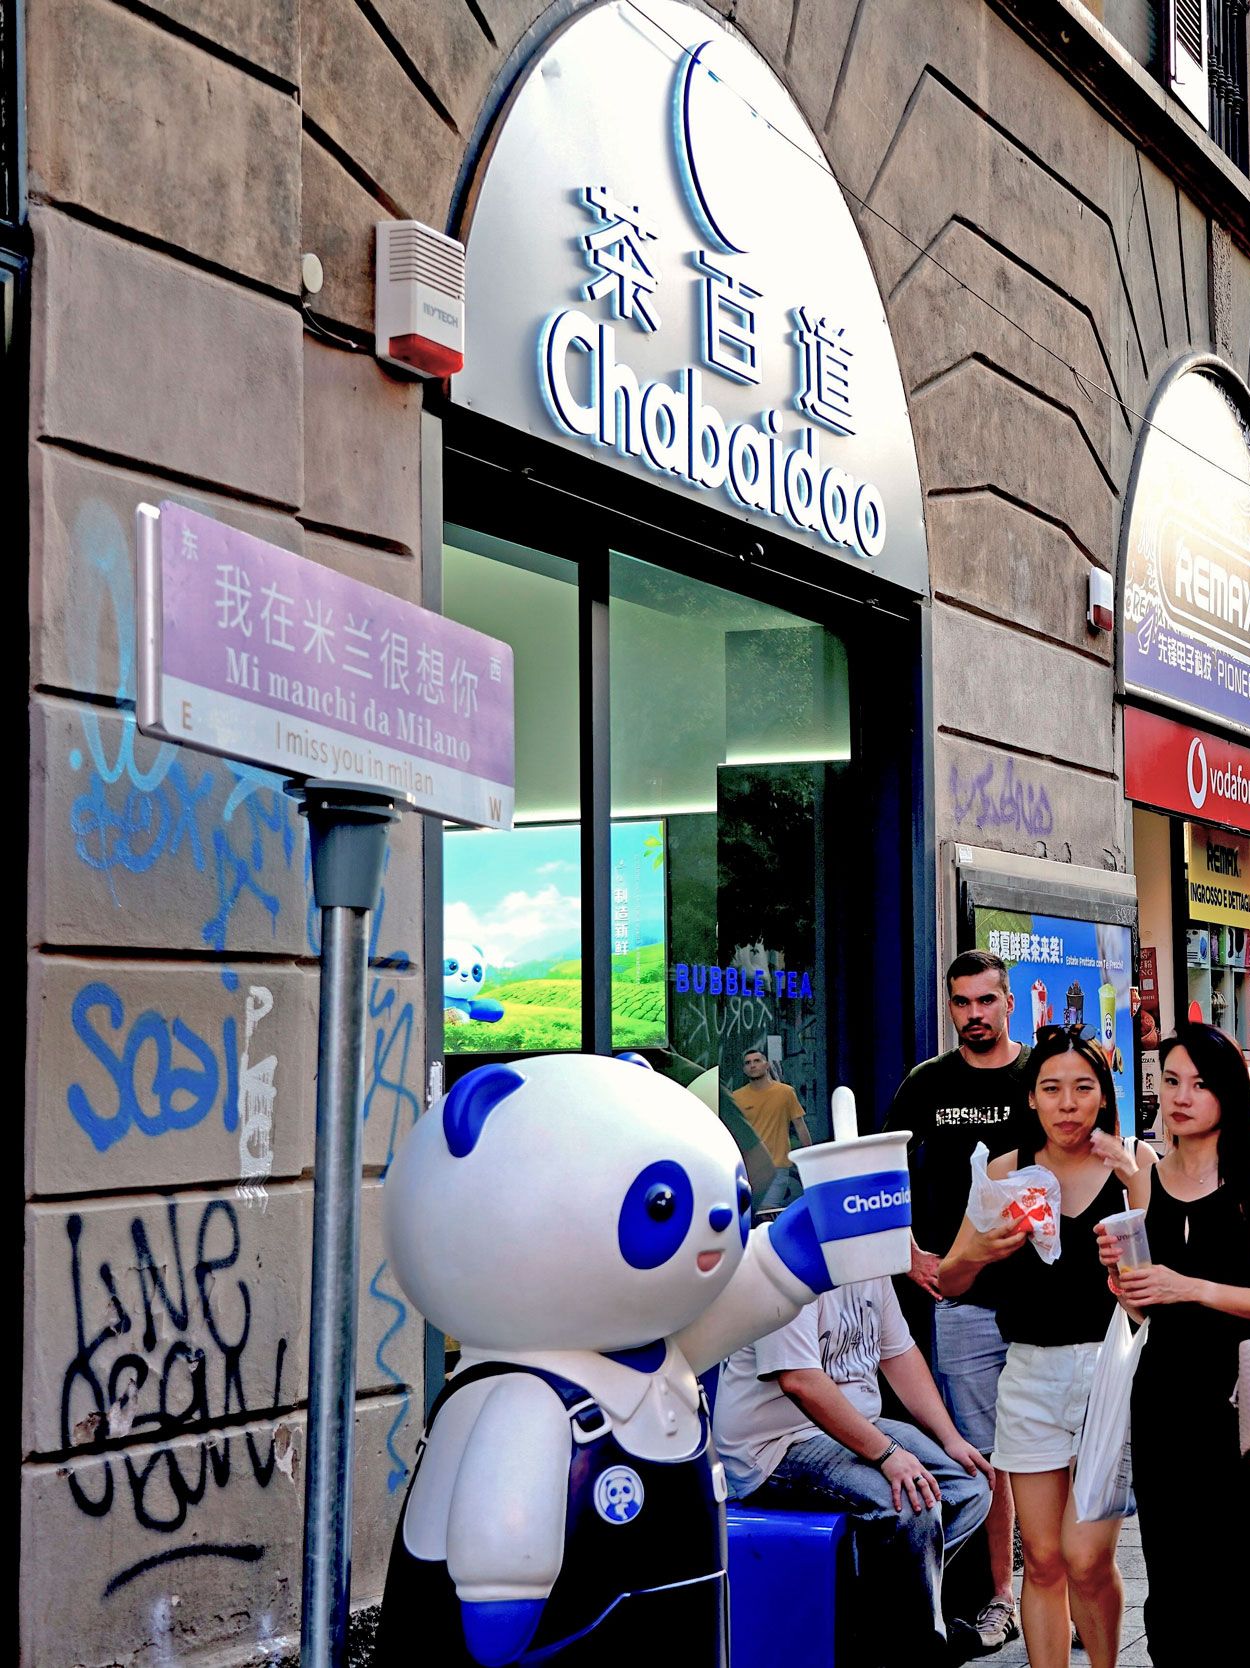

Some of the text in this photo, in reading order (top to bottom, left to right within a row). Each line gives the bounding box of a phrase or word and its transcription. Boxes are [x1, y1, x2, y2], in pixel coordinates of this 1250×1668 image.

[581, 186, 856, 436] 茶百道
[540, 310, 886, 558] Chabaidao
[181, 528, 199, 562] 东
[214, 563, 479, 718] 我在米兰很想你
[181, 700, 192, 731] E
[225, 646, 472, 764] Mi manchi da Milano
[275, 720, 434, 796] I miss you in milan
[489, 796, 502, 821] W
[1190, 882, 1223, 907] INGROSSO
[1223, 888, 1228, 908] E
[675, 963, 813, 999] BUBBLE TEA
